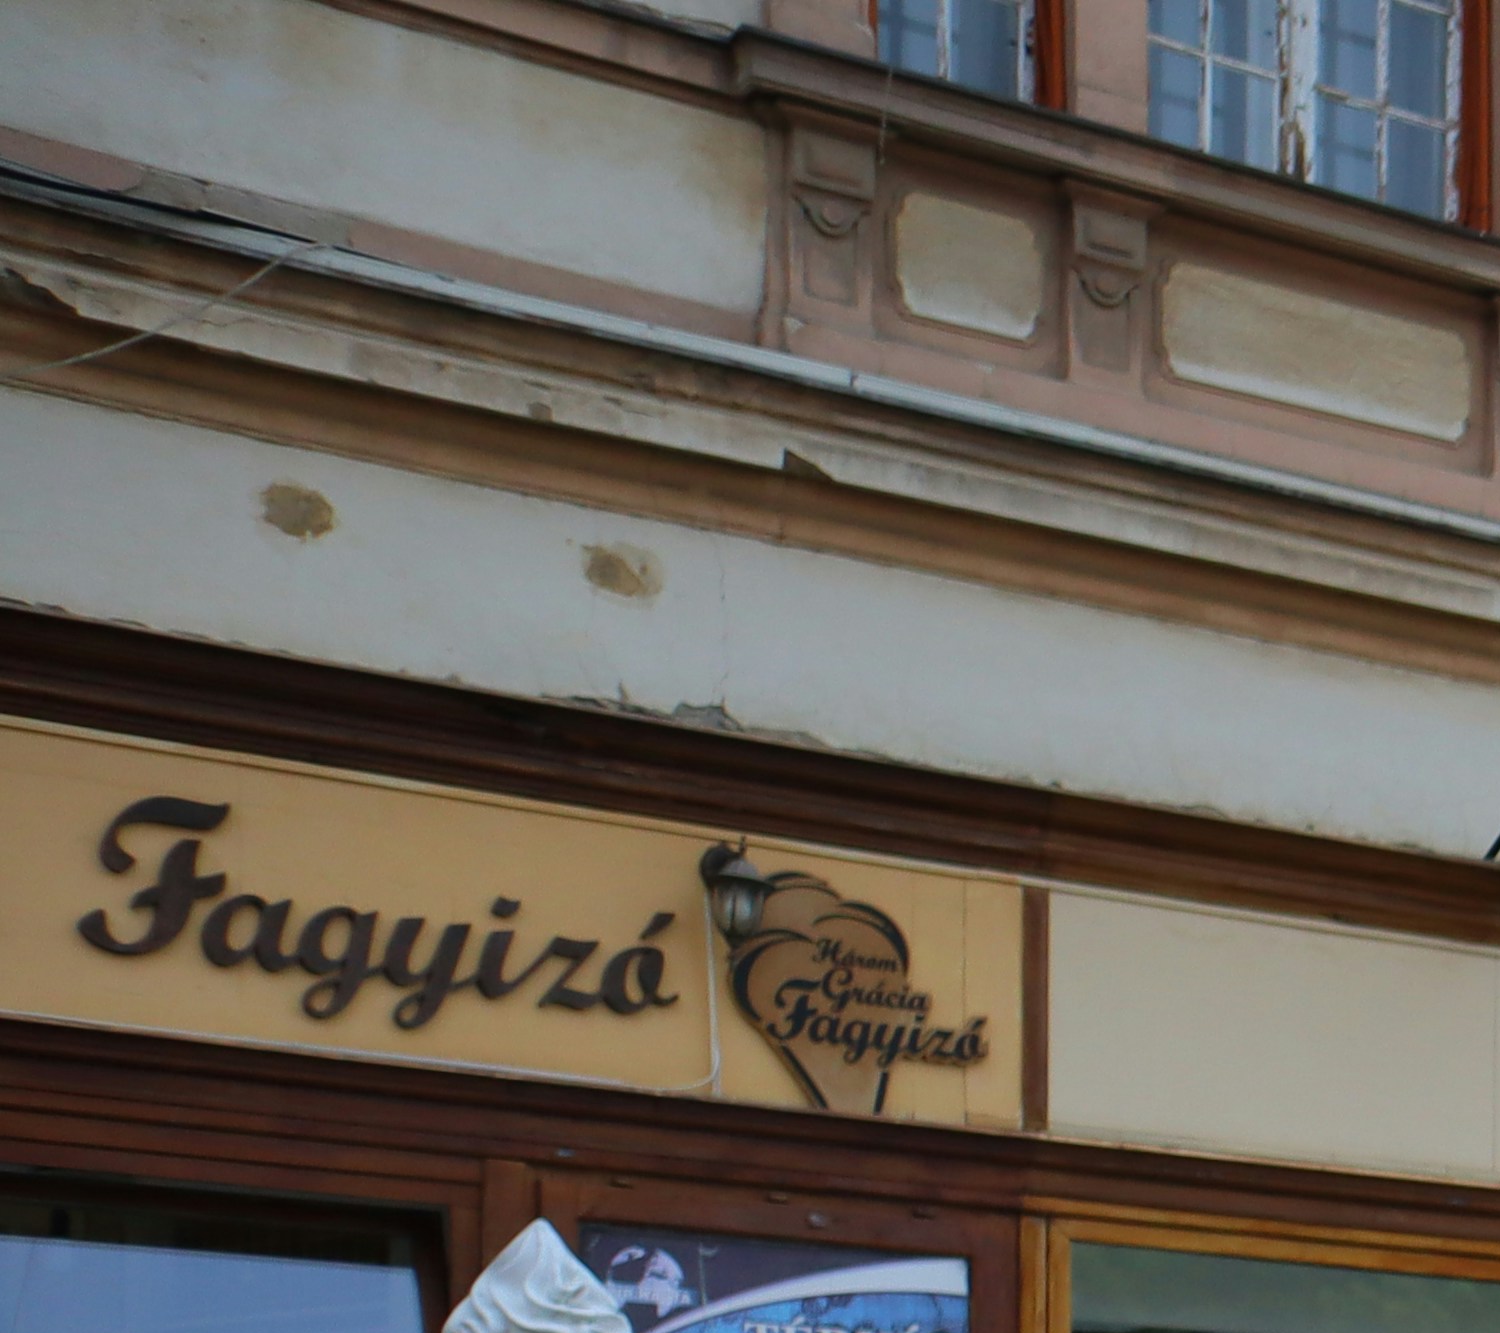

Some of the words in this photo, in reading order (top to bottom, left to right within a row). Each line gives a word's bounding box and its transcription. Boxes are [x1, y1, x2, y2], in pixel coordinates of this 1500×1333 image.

[75, 795, 681, 1030] Fagyizó
[812, 938, 897, 971] Három
[821, 967, 930, 1011] Grácia
[767, 979, 989, 1067] Fagyizó
